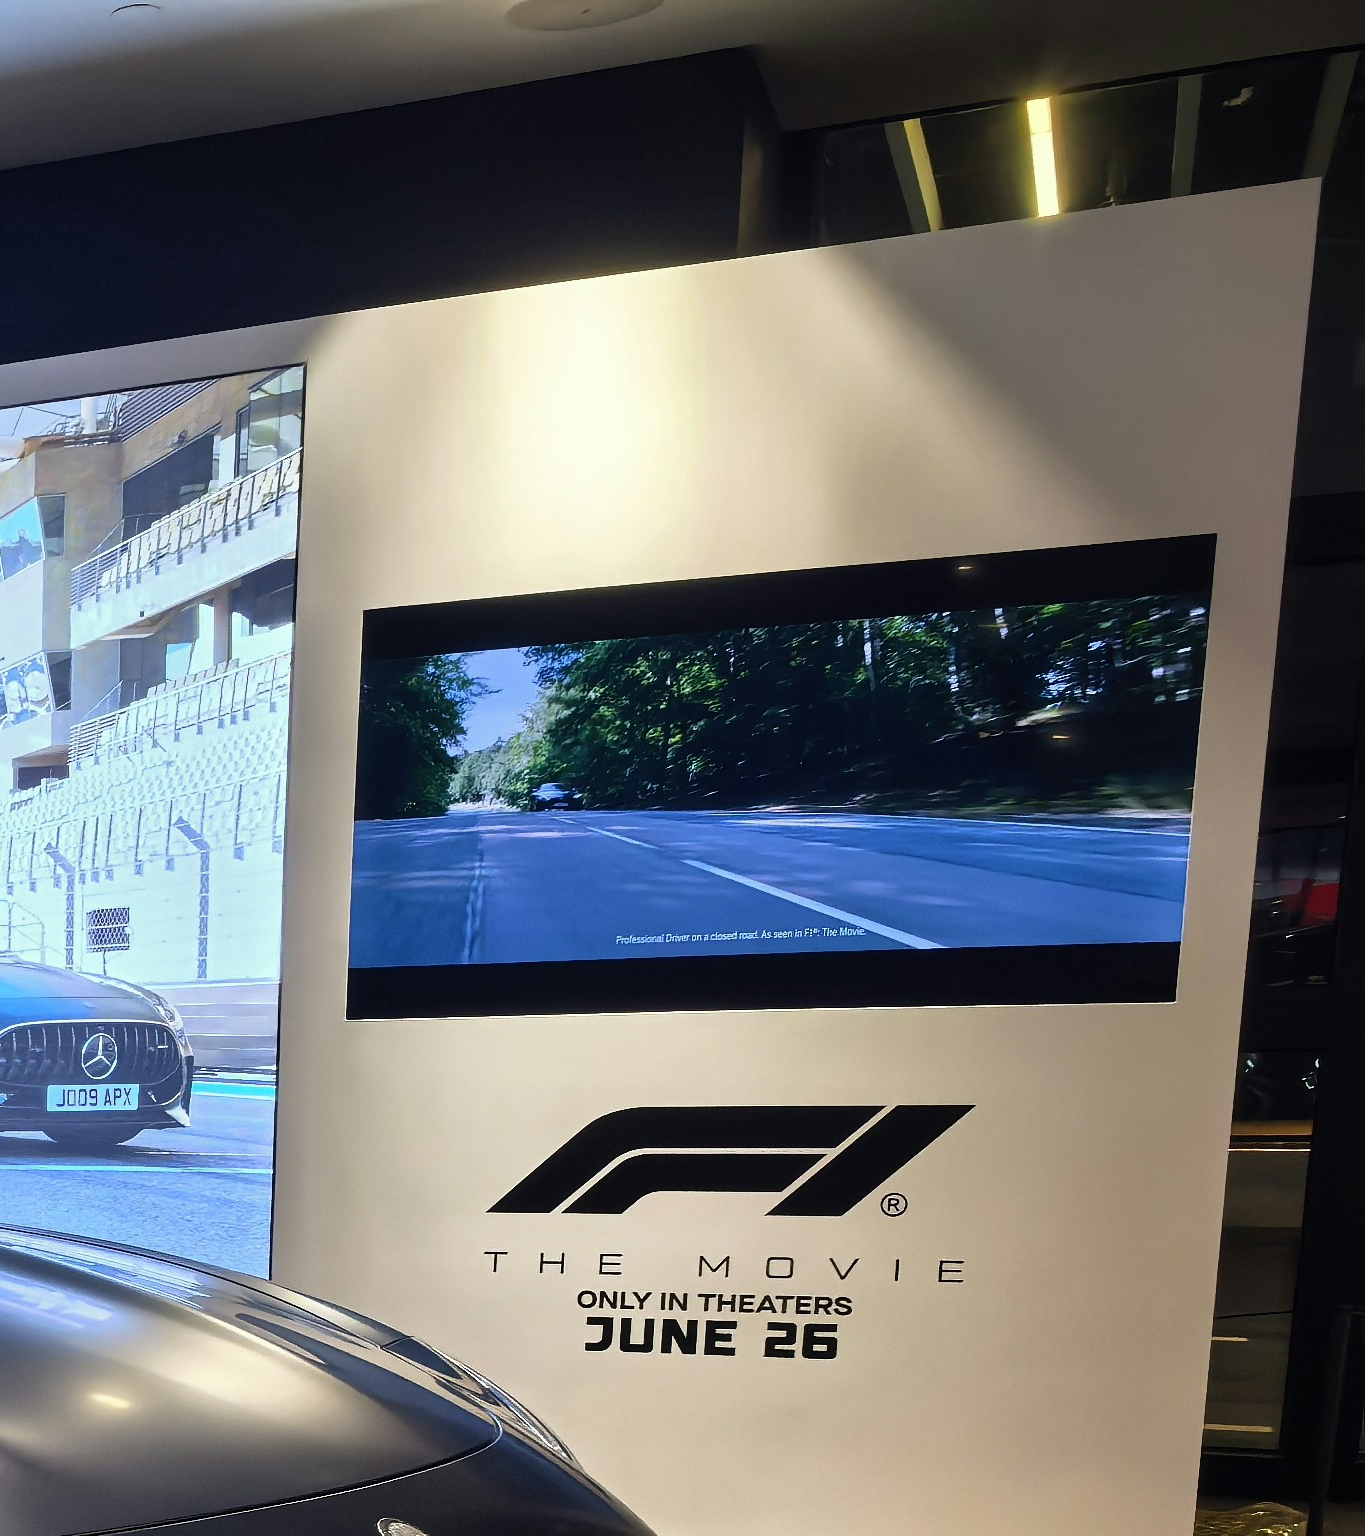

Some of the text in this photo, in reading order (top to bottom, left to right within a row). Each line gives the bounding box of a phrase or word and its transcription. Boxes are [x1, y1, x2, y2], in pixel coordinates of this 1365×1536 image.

[615, 934, 665, 945] Professional
[665, 933, 691, 943] Driver
[691, 933, 703, 942] on
[709, 930, 738, 941] closed
[760, 929, 773, 939] As
[773, 929, 793, 939] seen
[794, 928, 803, 938] in
[821, 926, 838, 937] The
[56, 1087, 132, 1107] J009 APX
[483, 1251, 966, 1284] THE MOVIE
[577, 1290, 853, 1316] ONLY IN THEATERS
[584, 1316, 839, 1360] JUNE 26
